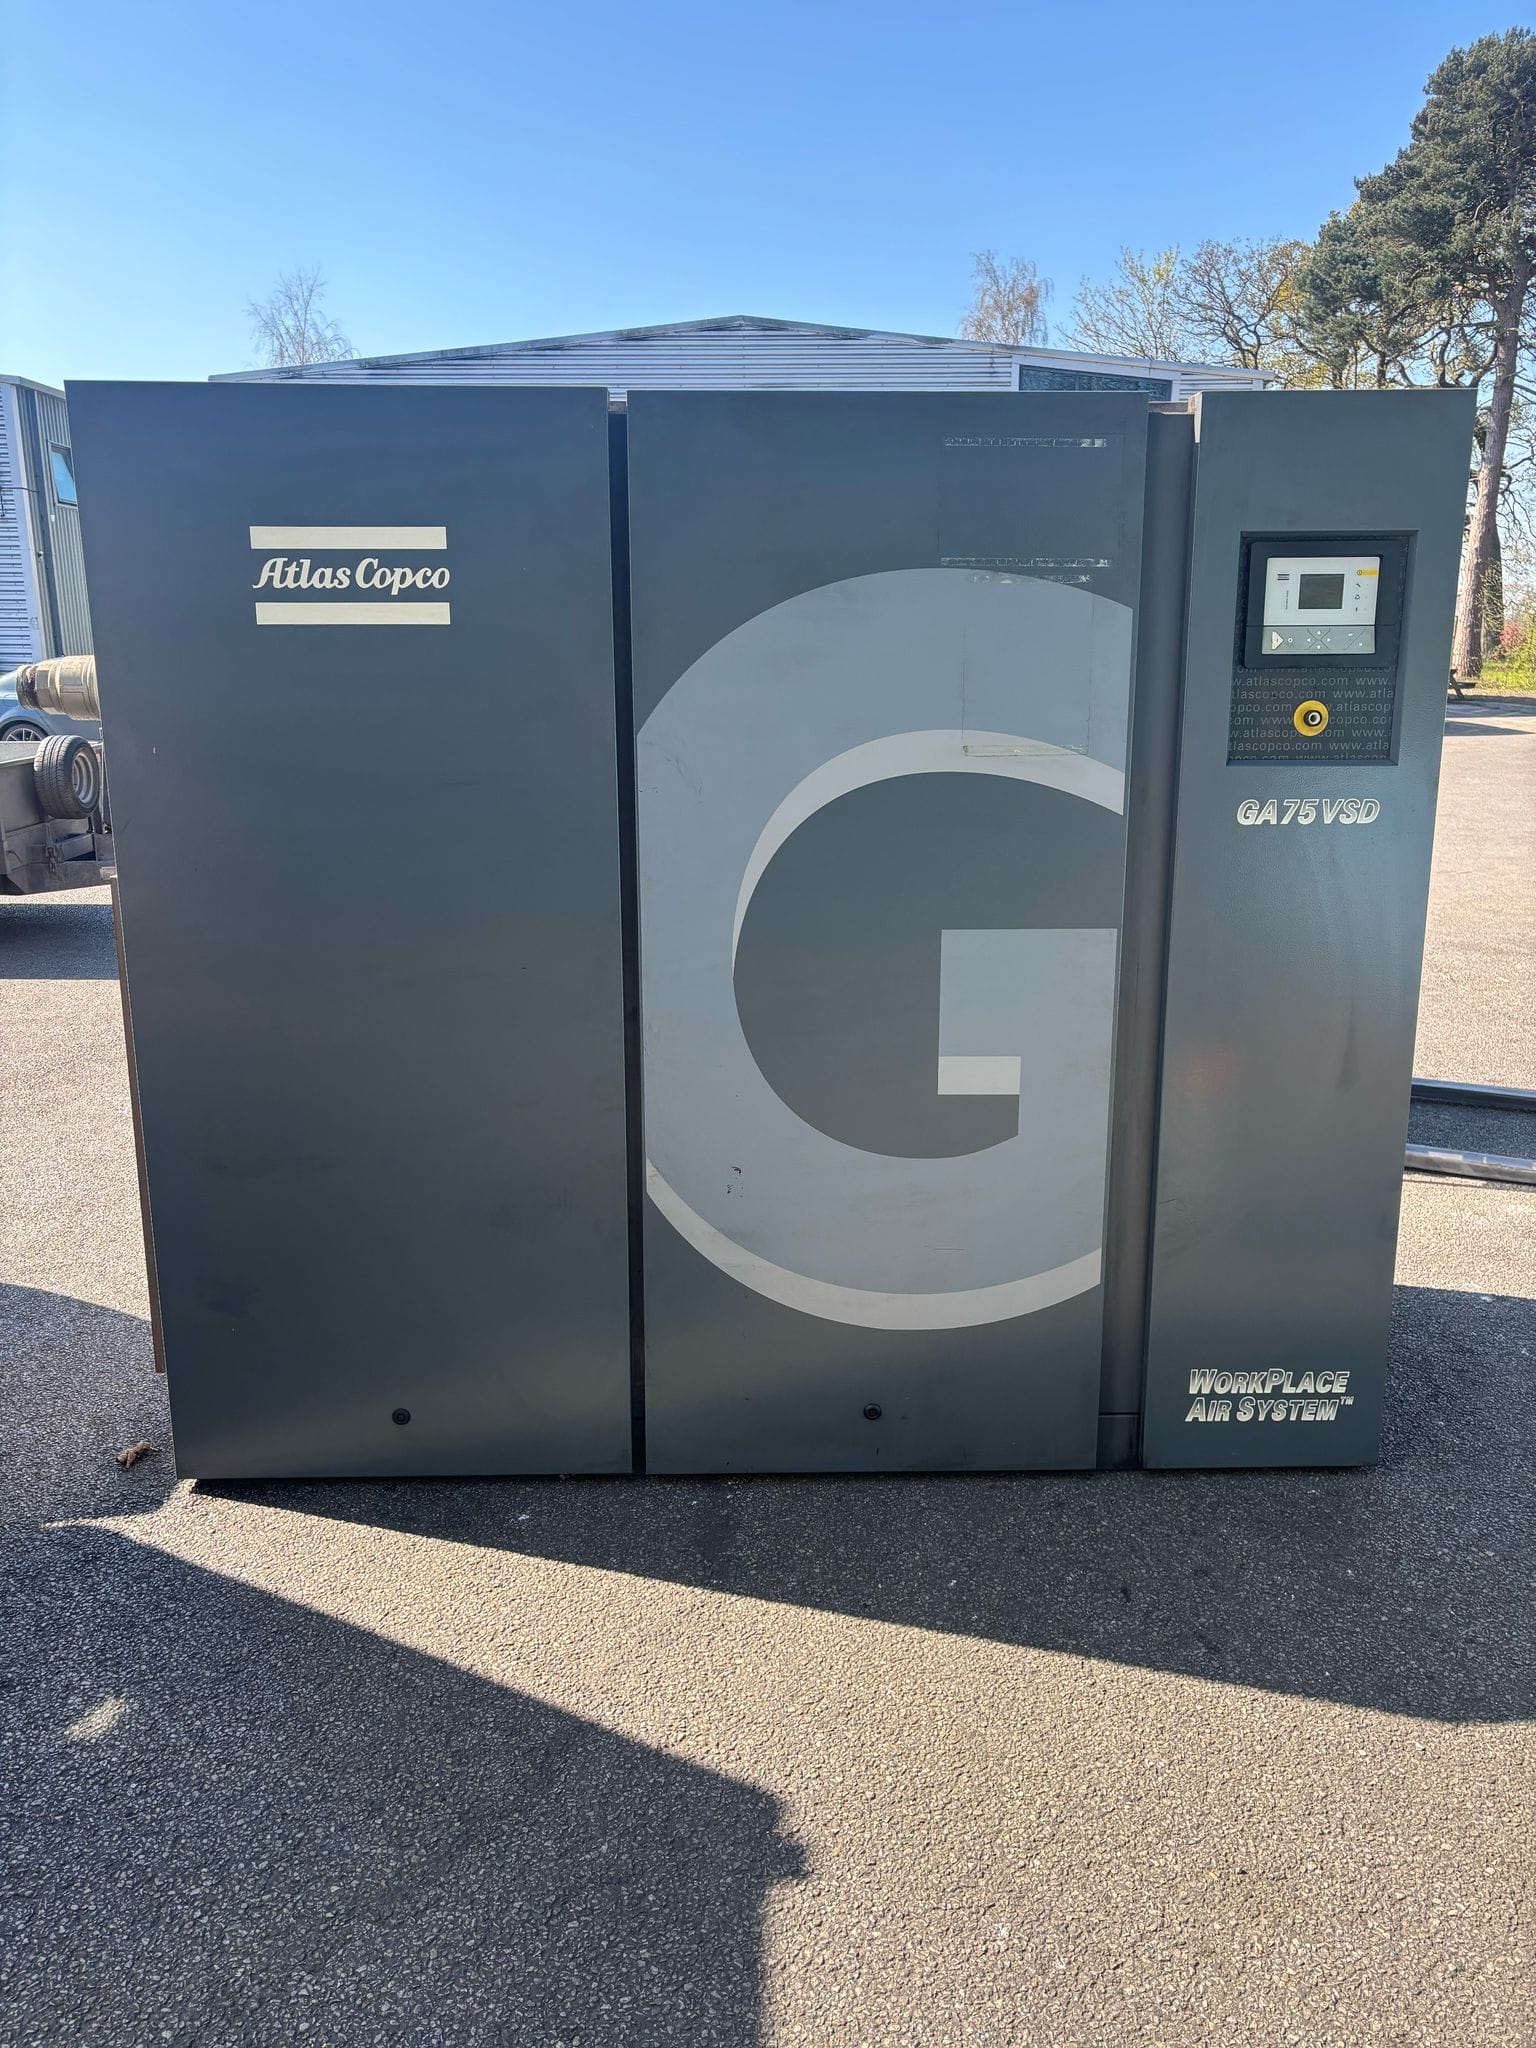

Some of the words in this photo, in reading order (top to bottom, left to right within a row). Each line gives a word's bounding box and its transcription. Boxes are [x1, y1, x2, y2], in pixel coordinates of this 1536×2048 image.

[253, 557, 351, 589] Atlas
[355, 557, 450, 595] Copco
[1230, 716, 1254, 726] om
[1322, 798, 1380, 824] VSD
